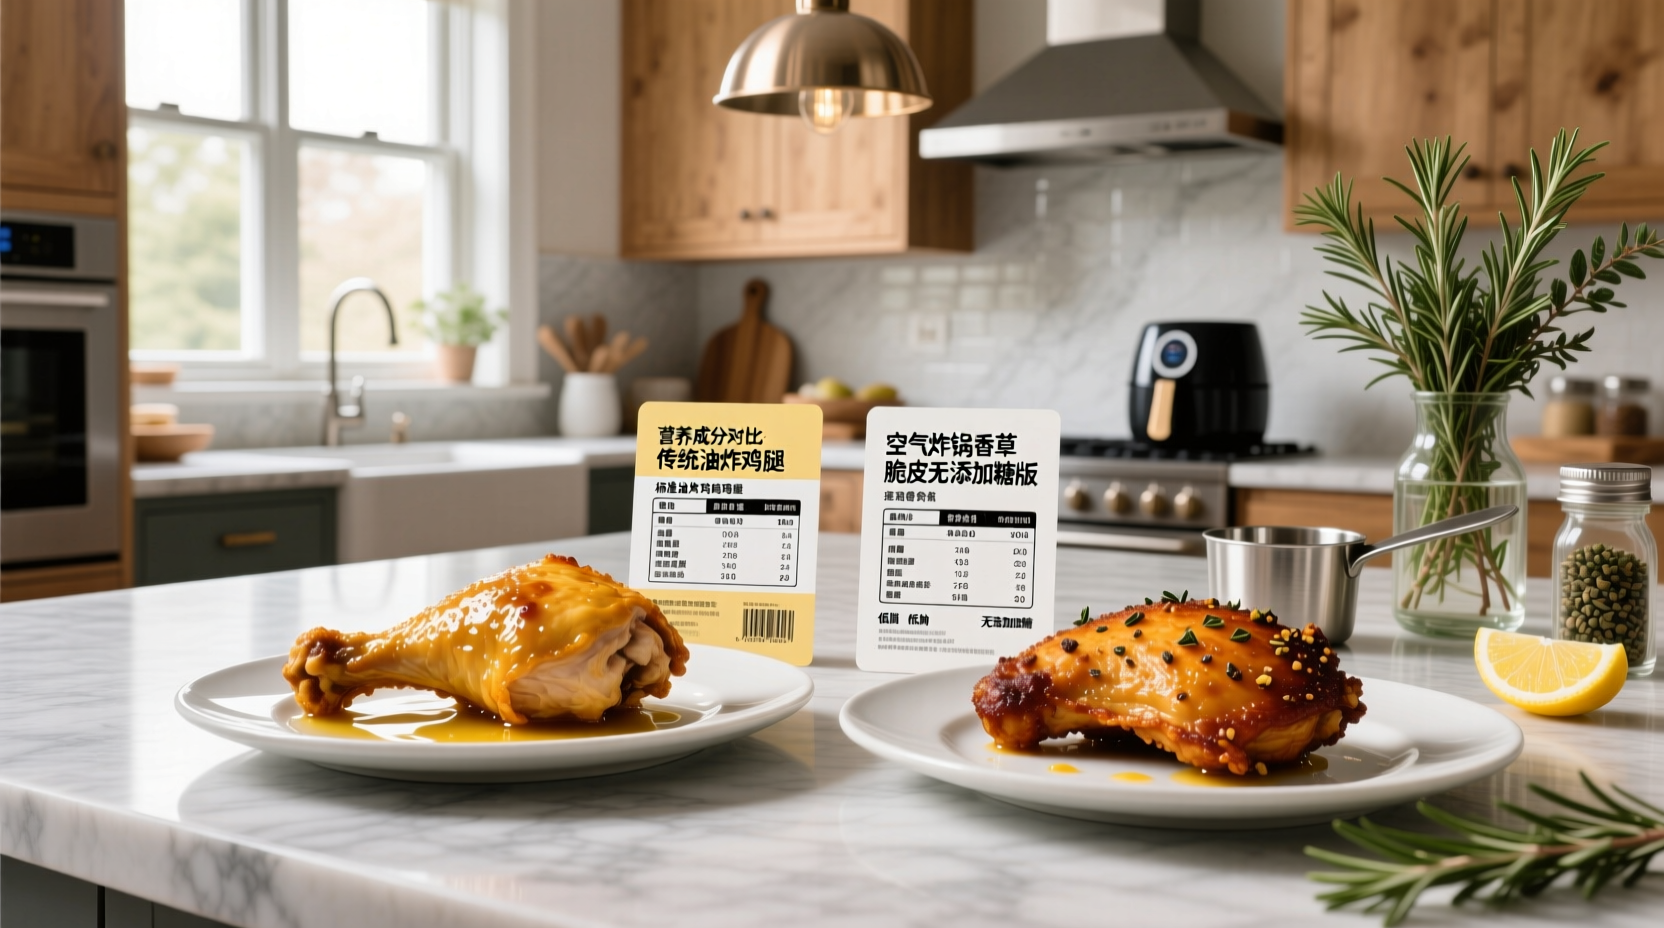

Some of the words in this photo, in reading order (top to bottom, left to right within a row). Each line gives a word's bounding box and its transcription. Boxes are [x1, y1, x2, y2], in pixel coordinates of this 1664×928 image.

[658, 426, 763, 446] 营养成分对比
[886, 431, 1018, 457] 空气炸锅香草
[657, 448, 785, 472] 传统油炸鸡腿
[883, 460, 1039, 486] 脆皮无添加糖版
